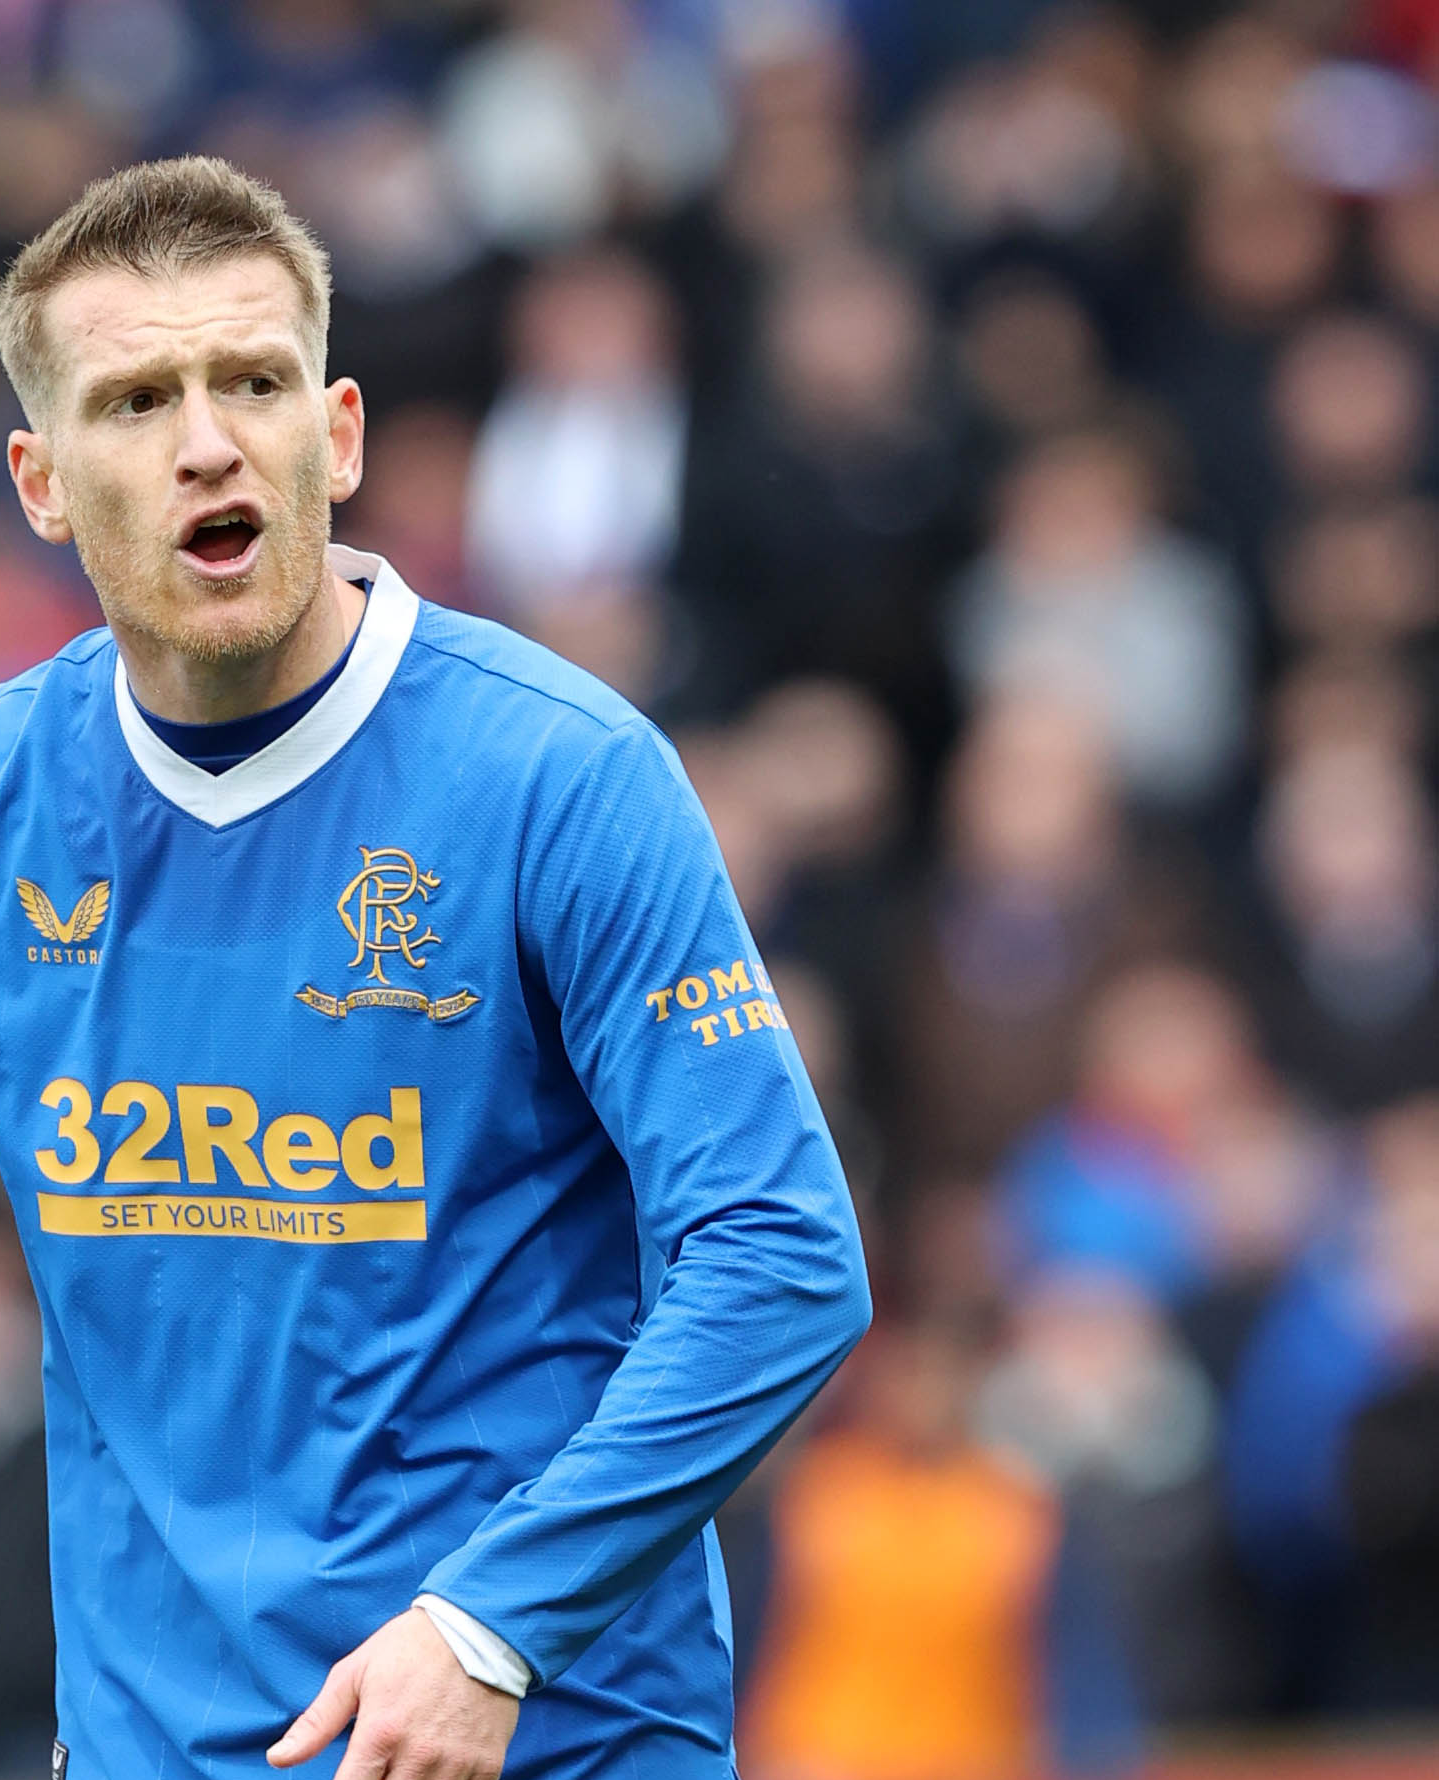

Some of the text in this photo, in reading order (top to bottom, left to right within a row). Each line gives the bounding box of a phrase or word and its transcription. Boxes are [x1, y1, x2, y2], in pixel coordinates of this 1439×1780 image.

[27, 946, 102, 965] CASTOR
[35, 1077, 425, 1191] 32Red
[101, 1204, 346, 1236] SET YOUR LIMITS
